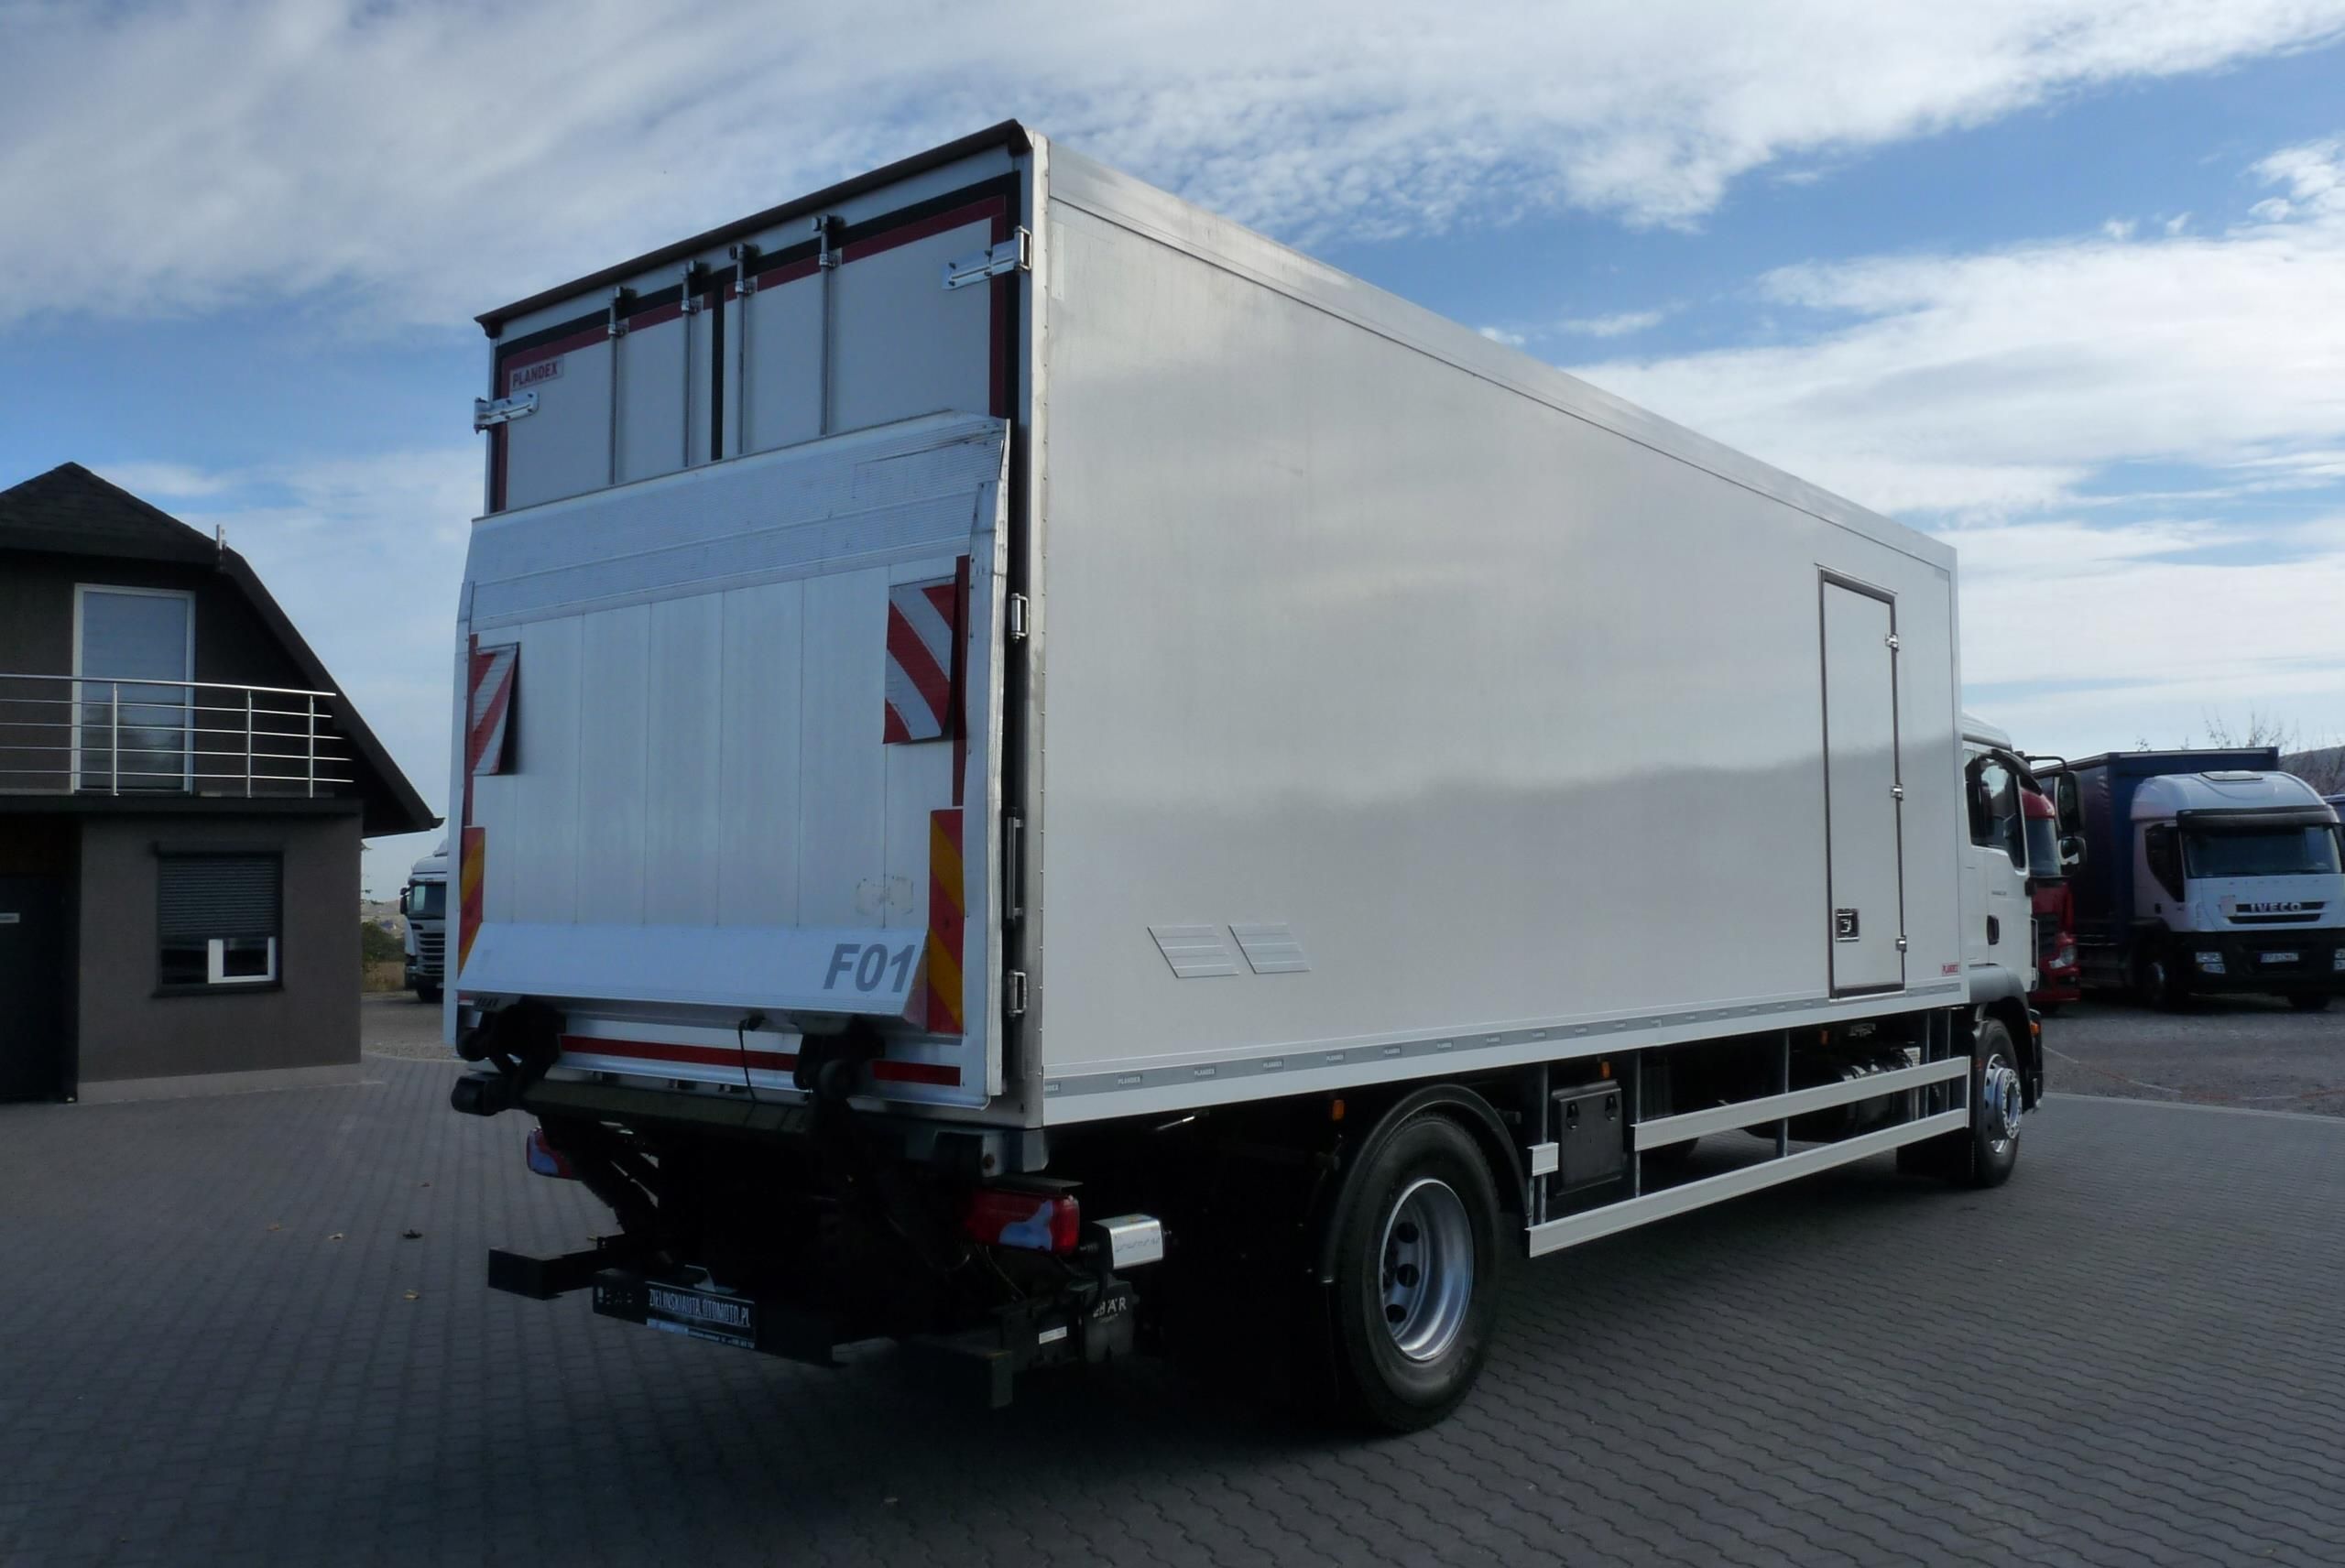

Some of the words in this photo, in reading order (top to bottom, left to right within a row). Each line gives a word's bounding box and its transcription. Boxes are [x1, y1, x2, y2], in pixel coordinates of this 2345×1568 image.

[512, 361, 558, 387] PLANDEX
[2250, 902, 2302, 912] IVECO
[823, 943, 915, 993] F01
